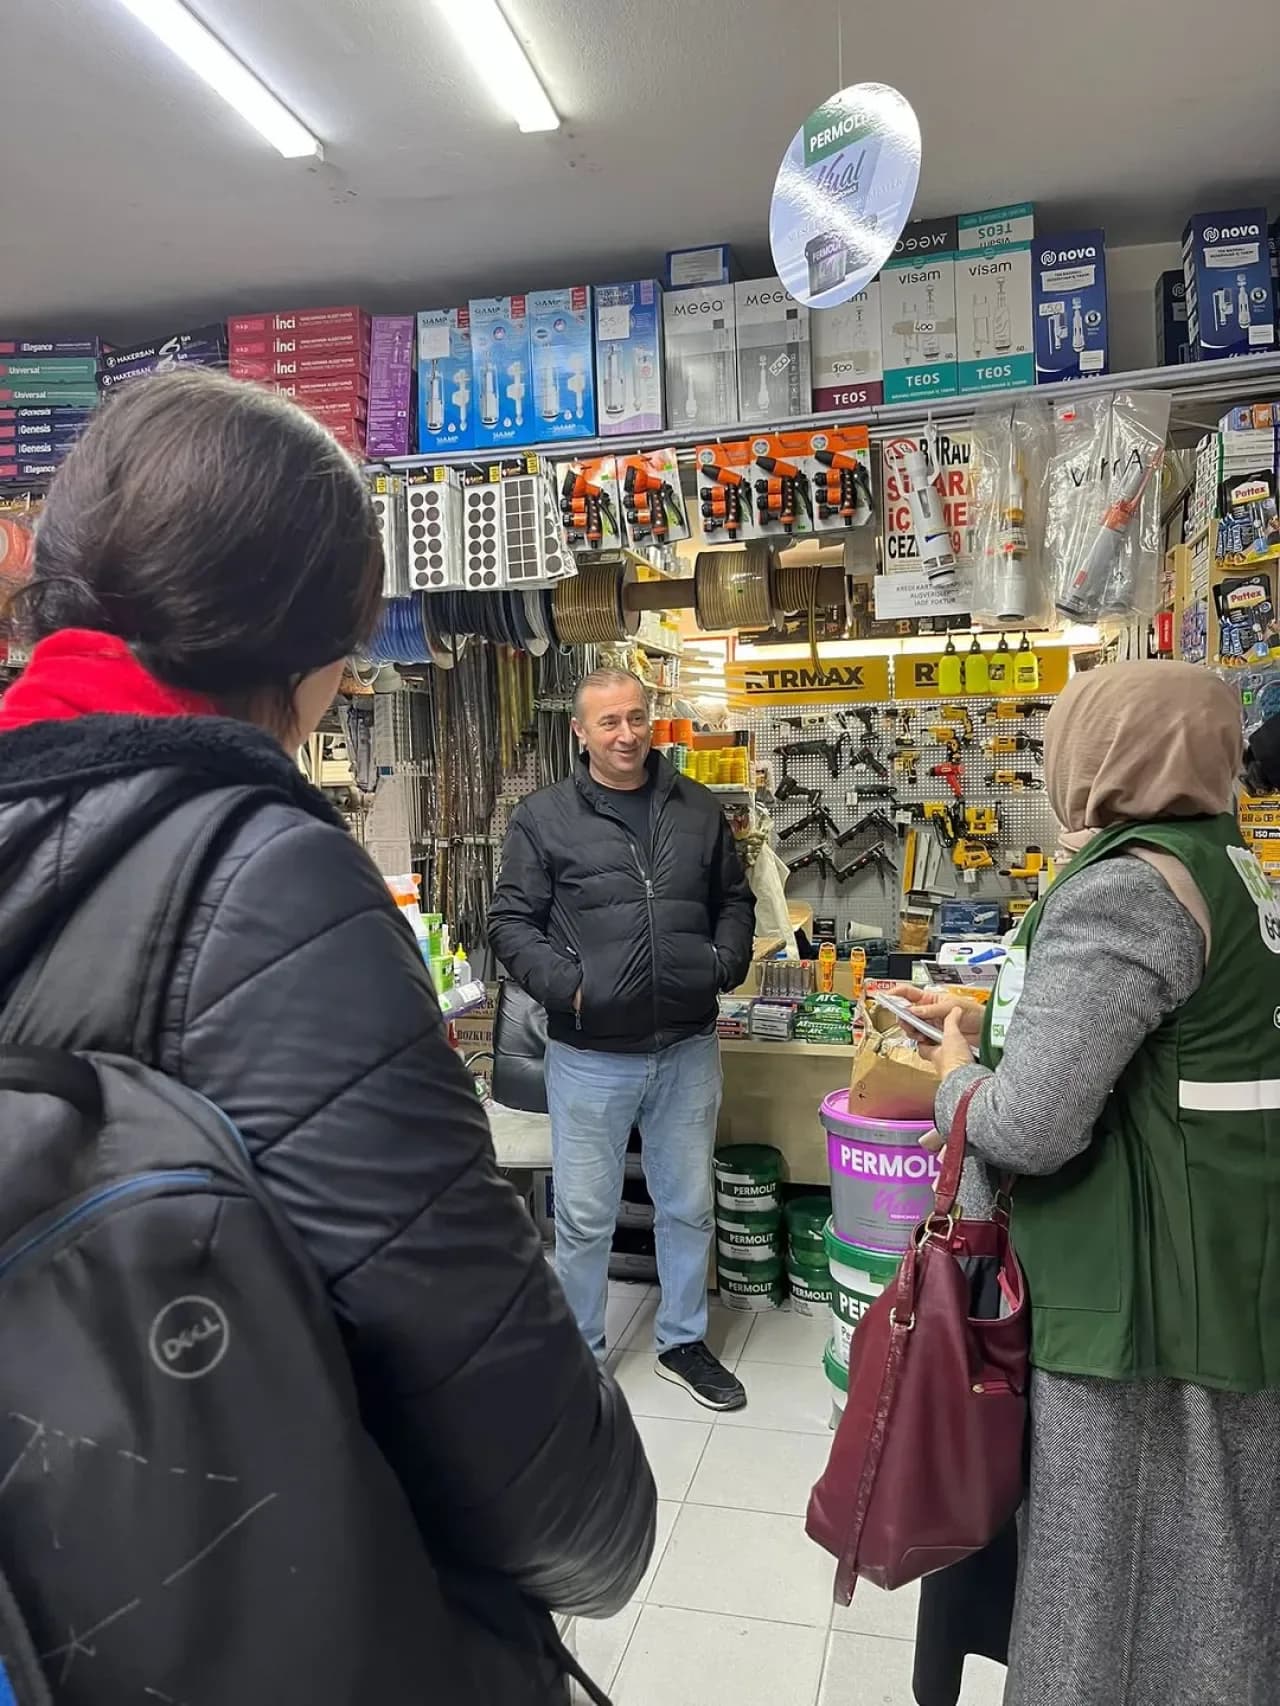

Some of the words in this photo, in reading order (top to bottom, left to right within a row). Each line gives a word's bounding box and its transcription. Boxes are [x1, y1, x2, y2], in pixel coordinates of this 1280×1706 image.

[978, 223, 1012, 239] TEOS
[1220, 225, 1259, 238] nova
[1058, 248, 1096, 260] nova
[969, 262, 1012, 276] visam
[899, 270, 941, 285] visam
[9, 366, 40, 374] Universal
[976, 366, 1011, 380] TEOS
[905, 373, 940, 387] TEOS
[14, 391, 46, 400] Universal
[833, 391, 867, 405] TEOS
[21, 424, 51, 434] Genesis
[21, 443, 52, 453] Genesis
[1235, 485, 1265, 499] Pattex
[1231, 590, 1262, 603] Pattex
[745, 666, 865, 689] RTRMAX
[816, 994, 841, 1002] ATC
[457, 1031, 493, 1041] BOZKUR
[840, 1144, 941, 1178] PERMOL
[734, 1183, 776, 1196] PERMOLIT
[730, 1233, 773, 1245] PERMOLIT
[729, 1282, 772, 1294] PERMOLIT
[161, 1316, 220, 1361] DELL
